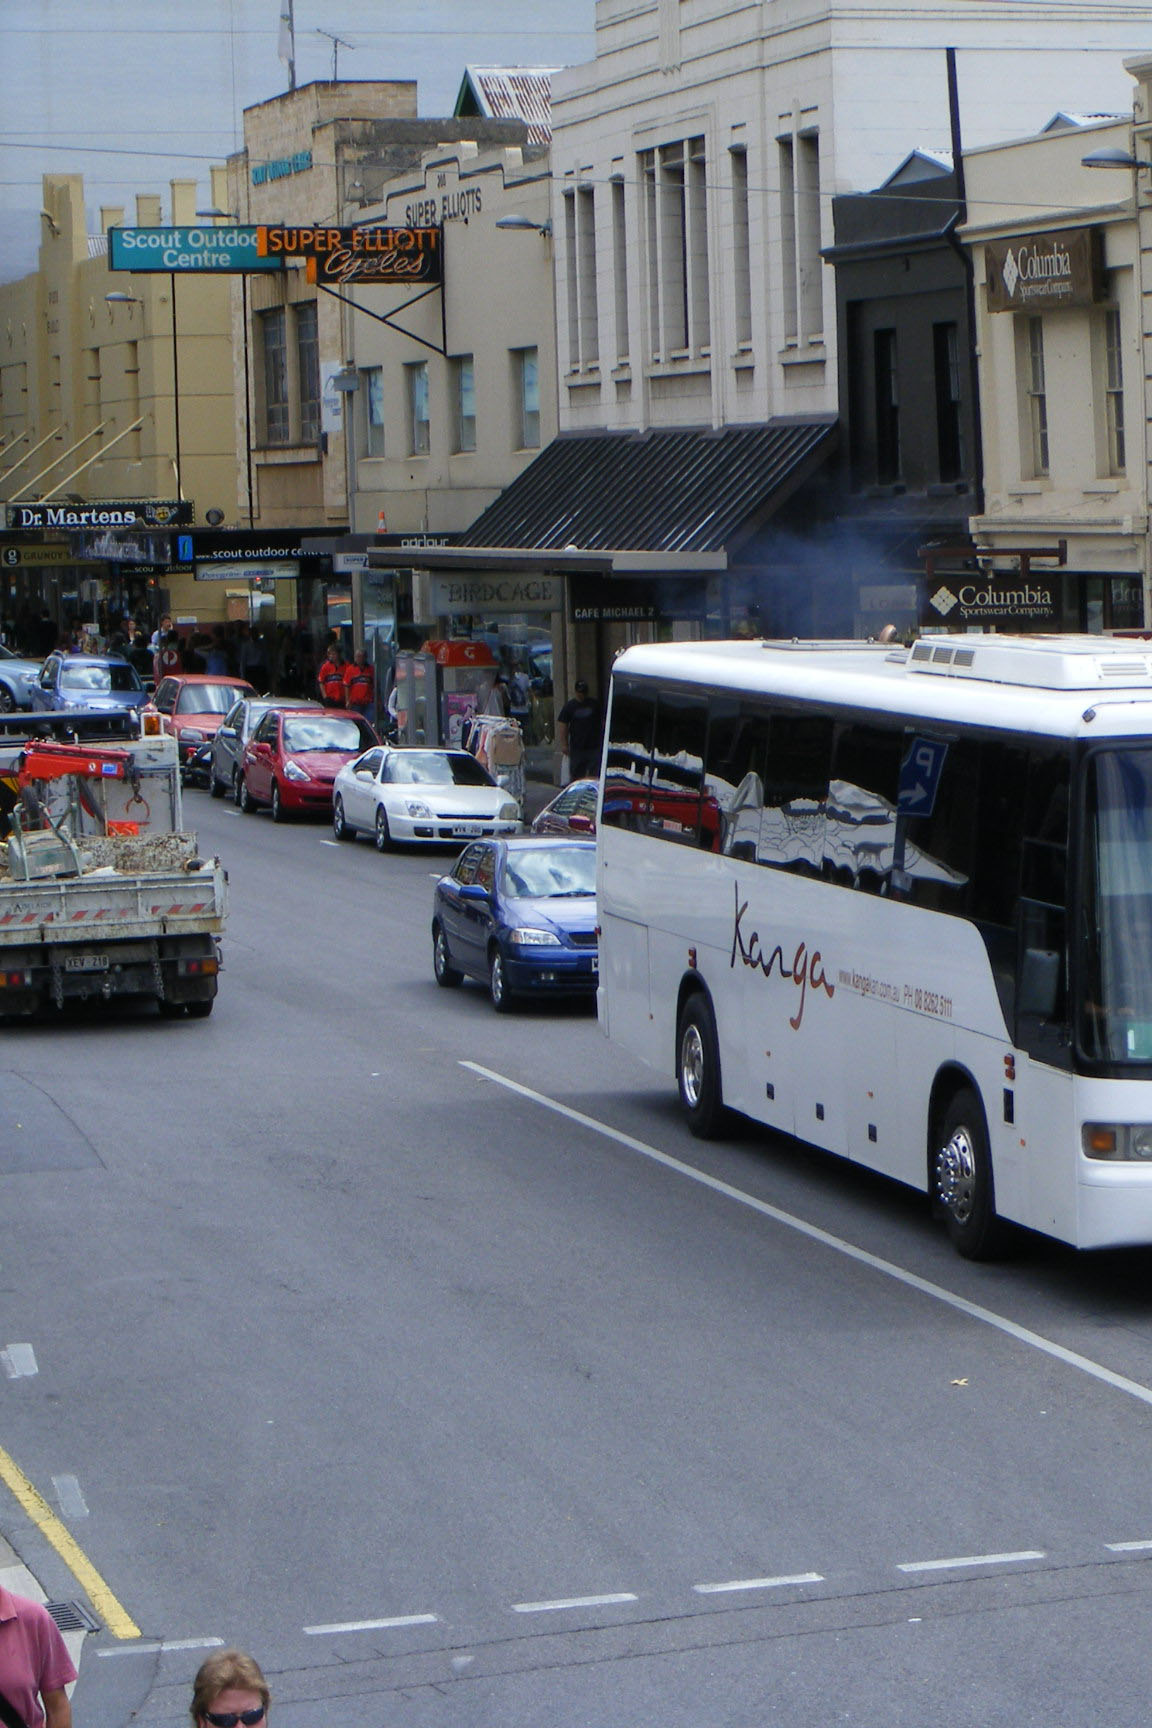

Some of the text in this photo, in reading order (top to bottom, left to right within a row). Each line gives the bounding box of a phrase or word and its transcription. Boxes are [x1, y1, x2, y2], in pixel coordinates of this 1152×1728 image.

[406, 188, 482, 226] SUPER ELLIOTTS
[122, 230, 181, 248] Scout
[268, 228, 439, 251] SUPER ELLIOTT
[163, 250, 231, 267] Centre
[325, 249, 425, 283] Cycles
[1018, 242, 1072, 280] Columbia
[21, 508, 43, 526] Dr.
[46, 508, 136, 526] Martens
[245, 546, 289, 557] outdoor
[448, 581, 553, 602] BIRDCAGE
[958, 585, 1052, 606] Columbia
[575, 608, 599, 618] CAFE
[602, 607, 644, 617] MICHAEL
[731, 880, 834, 1031] Kanga
